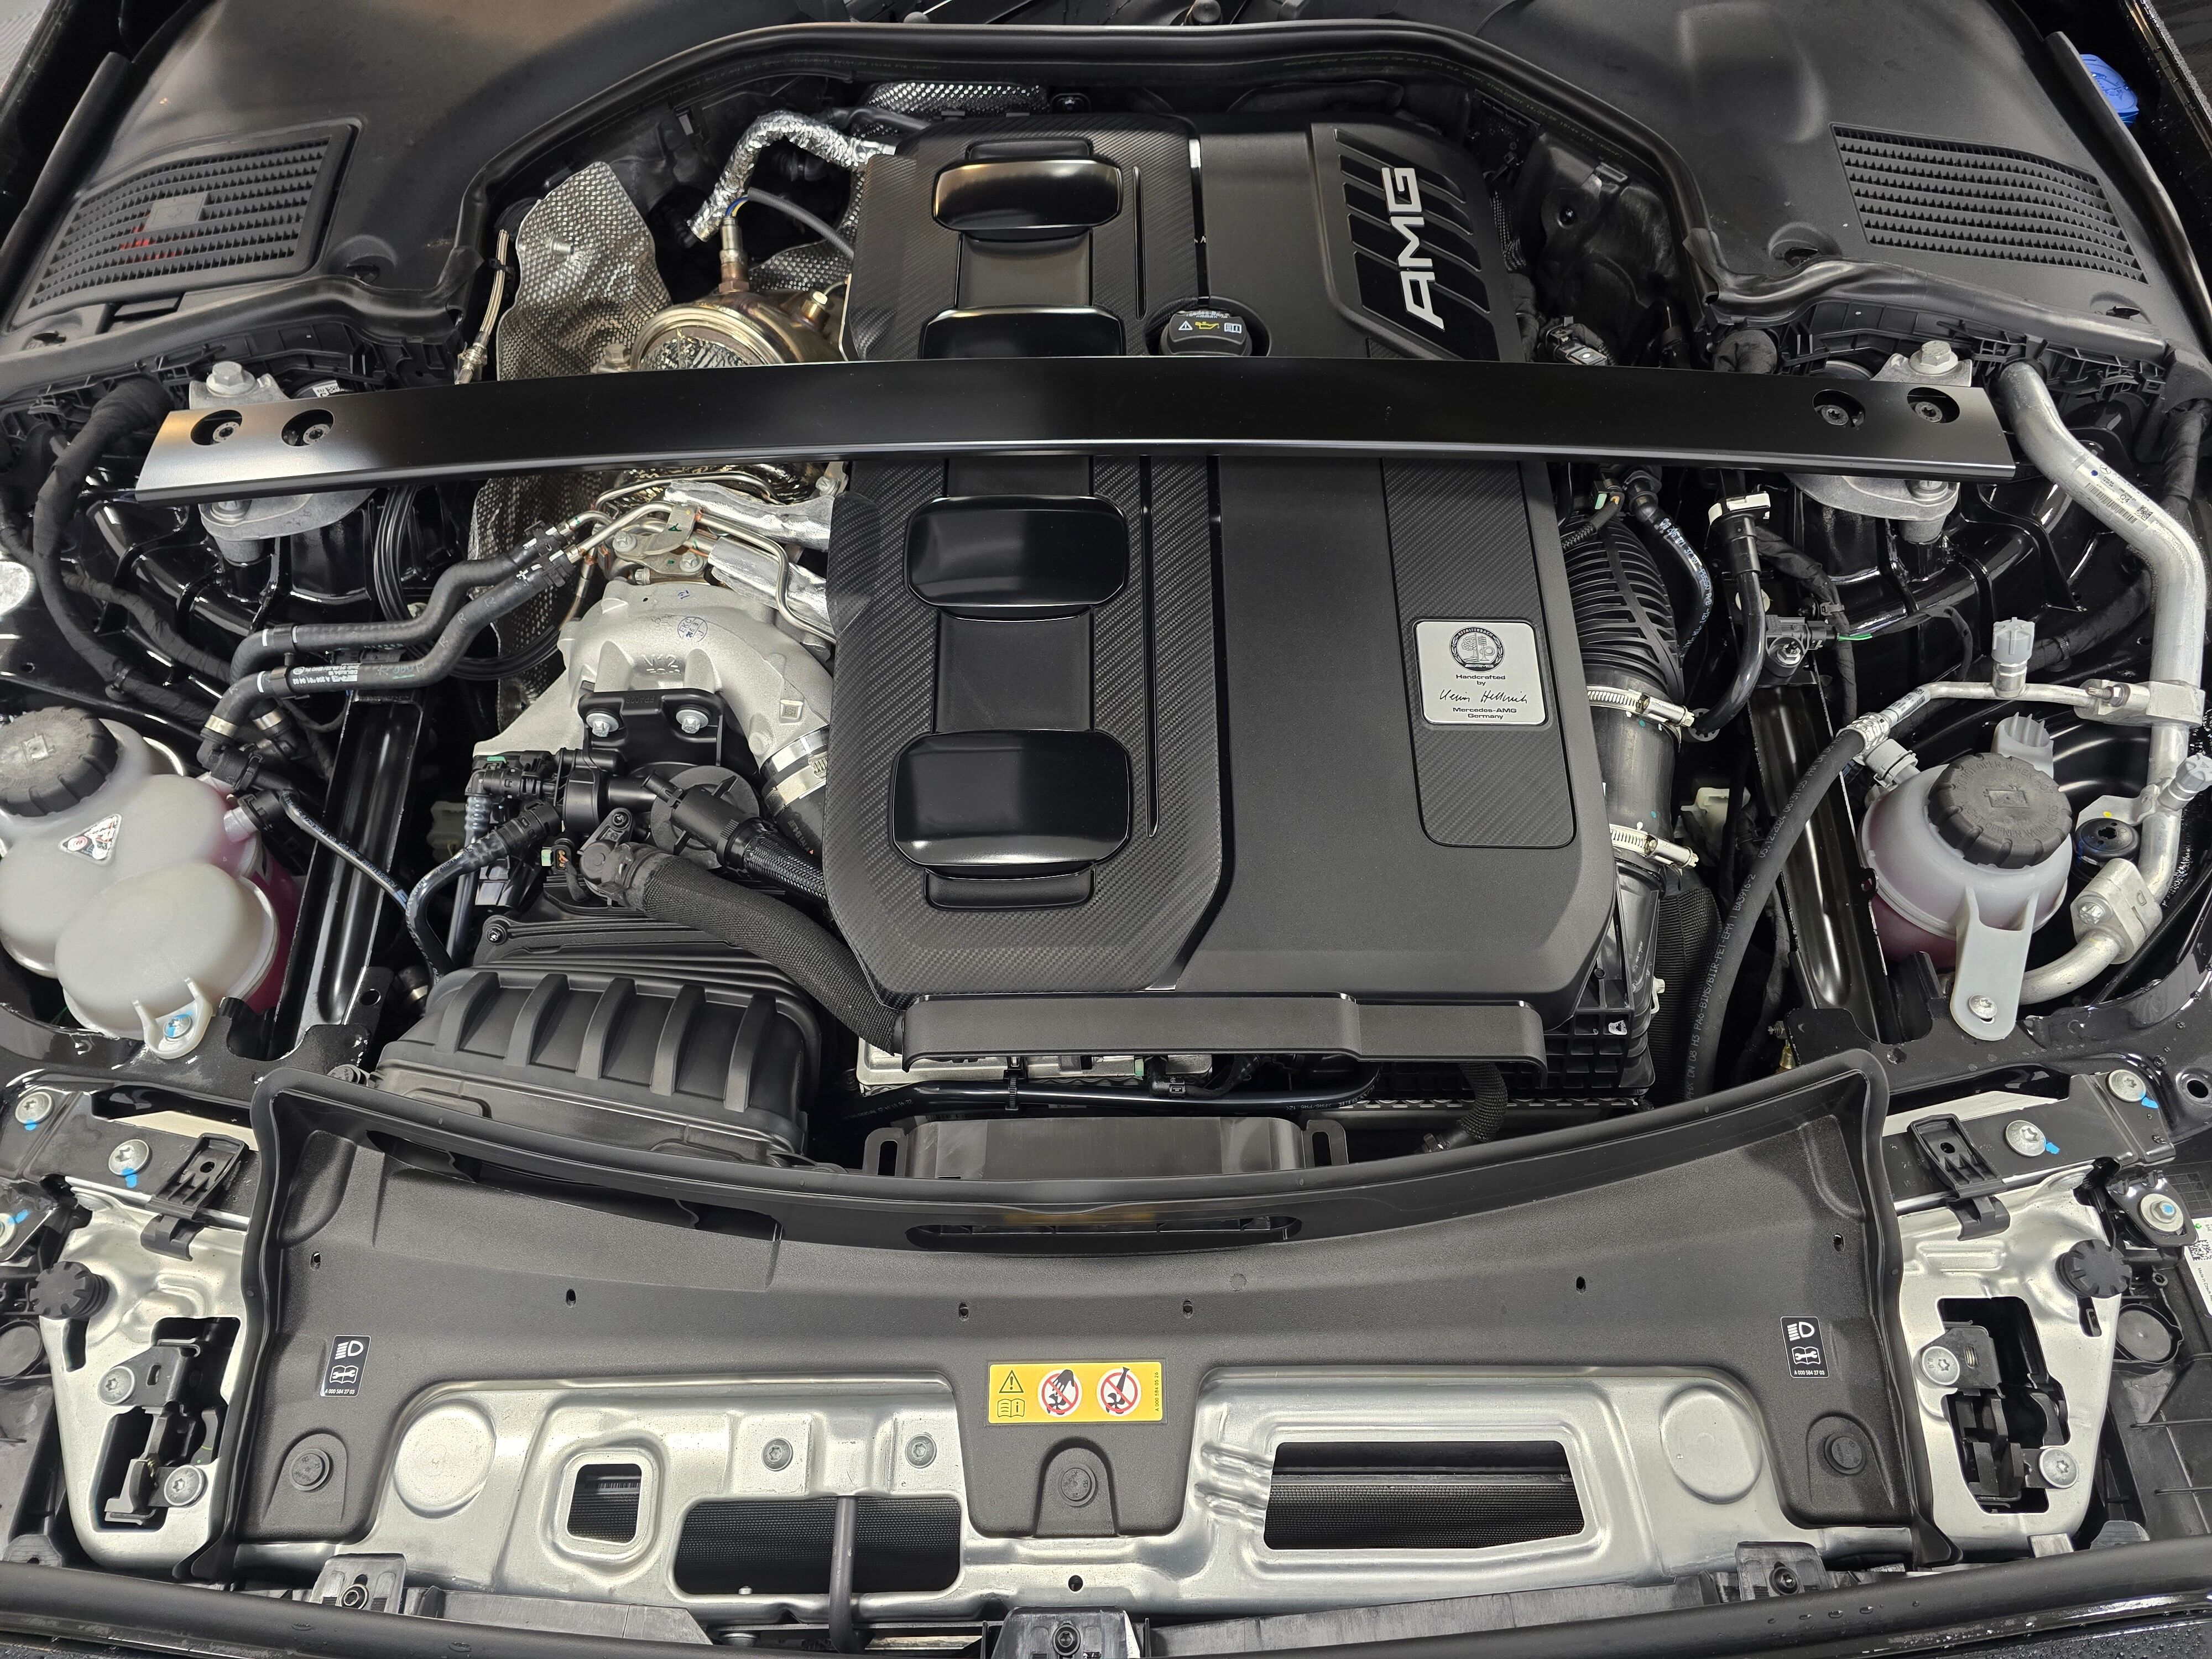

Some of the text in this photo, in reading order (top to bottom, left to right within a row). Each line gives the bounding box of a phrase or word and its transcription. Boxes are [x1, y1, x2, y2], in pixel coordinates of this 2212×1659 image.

[1381, 168, 1444, 331] AMG
[458, 612, 467, 624] R
[678, 617, 693, 633] EKC
[1755, 813, 1789, 860] 05.12.2024
[1732, 871, 1756, 912] BA3916-2
[1689, 1033, 1701, 1047] H3
[1687, 1065, 1696, 1078] DN
